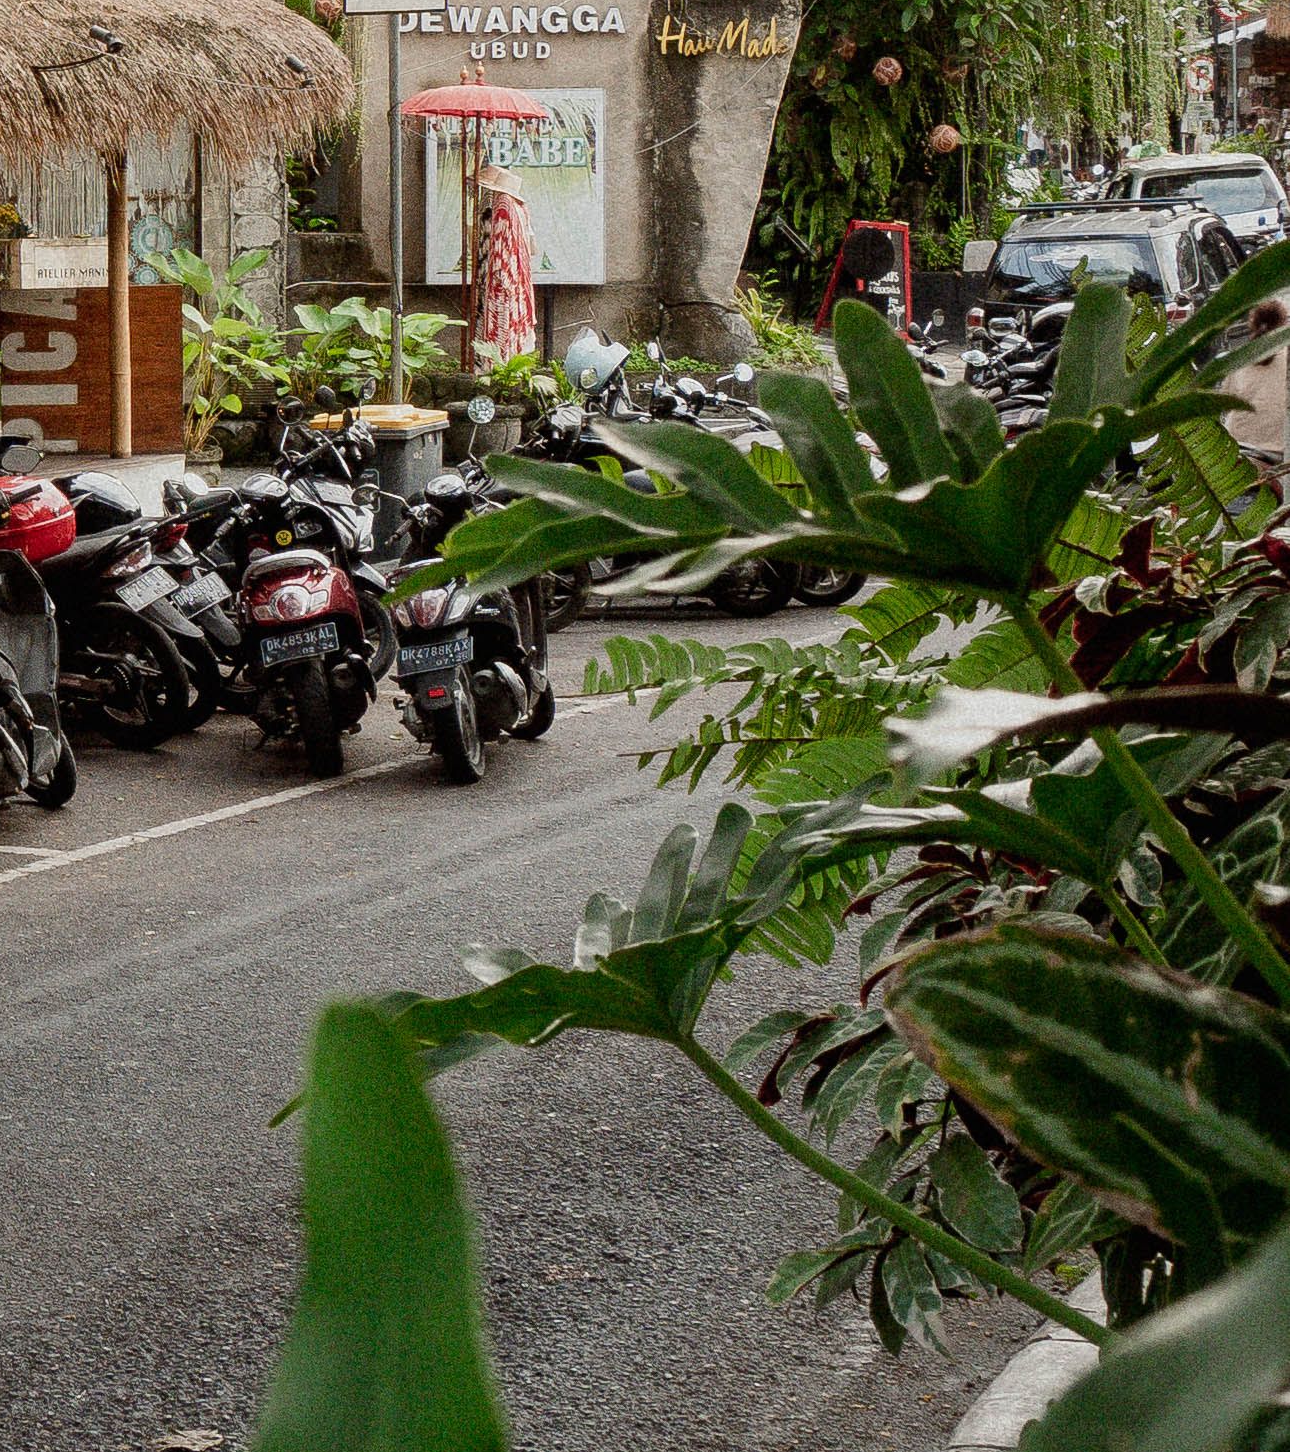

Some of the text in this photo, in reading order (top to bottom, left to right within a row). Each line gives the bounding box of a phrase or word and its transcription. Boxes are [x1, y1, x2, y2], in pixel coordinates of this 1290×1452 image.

[399, 5, 626, 34] DEWANGGA
[470, 41, 551, 60] UBUD
[491, 137, 588, 168] BABE
[37, 268, 108, 278] ATELIER MANI
